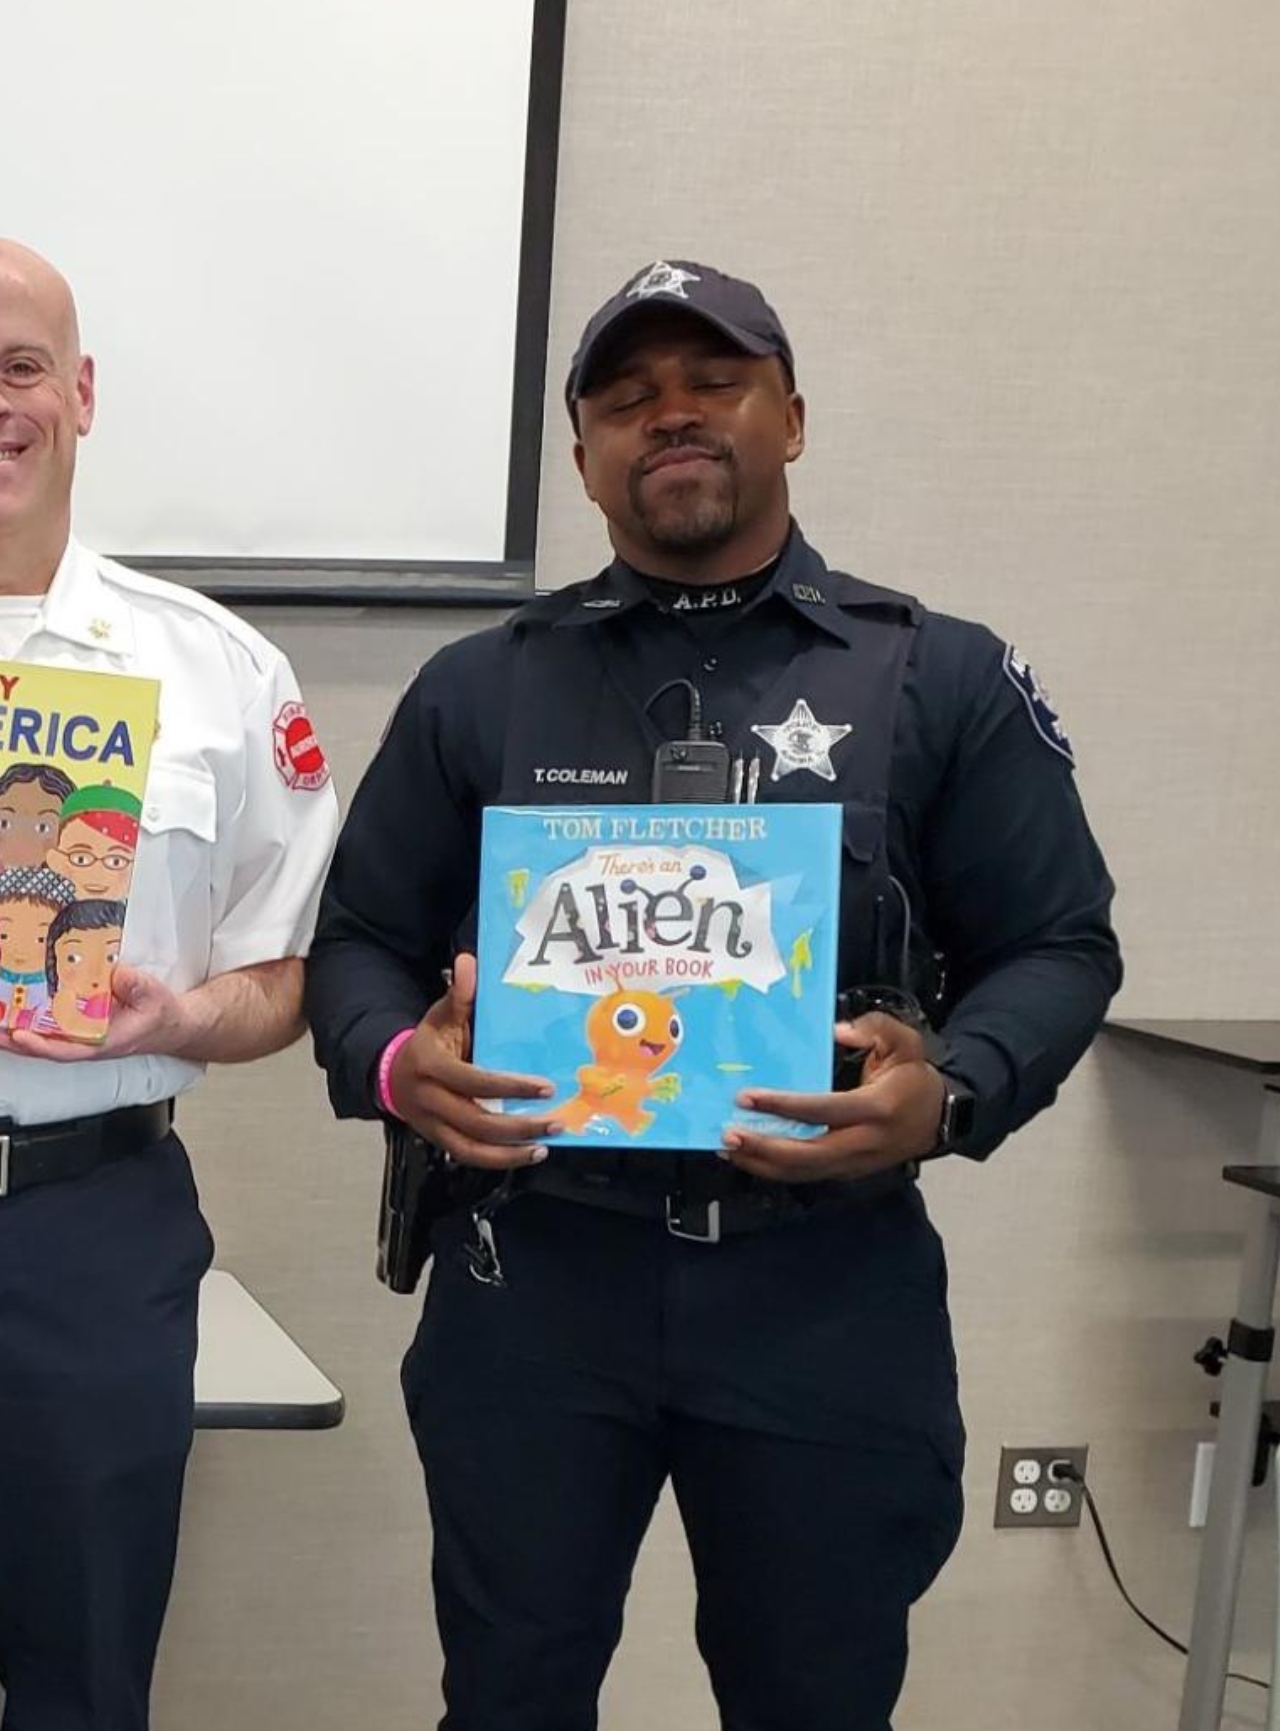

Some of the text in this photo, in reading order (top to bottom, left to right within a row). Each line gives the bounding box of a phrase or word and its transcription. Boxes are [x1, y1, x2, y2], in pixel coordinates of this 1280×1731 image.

[544, 817, 767, 841] TOM FLETCHER
[599, 853, 682, 876] There's an
[528, 875, 753, 966] Alien
[585, 958, 713, 985] IN YOUR BOOK
